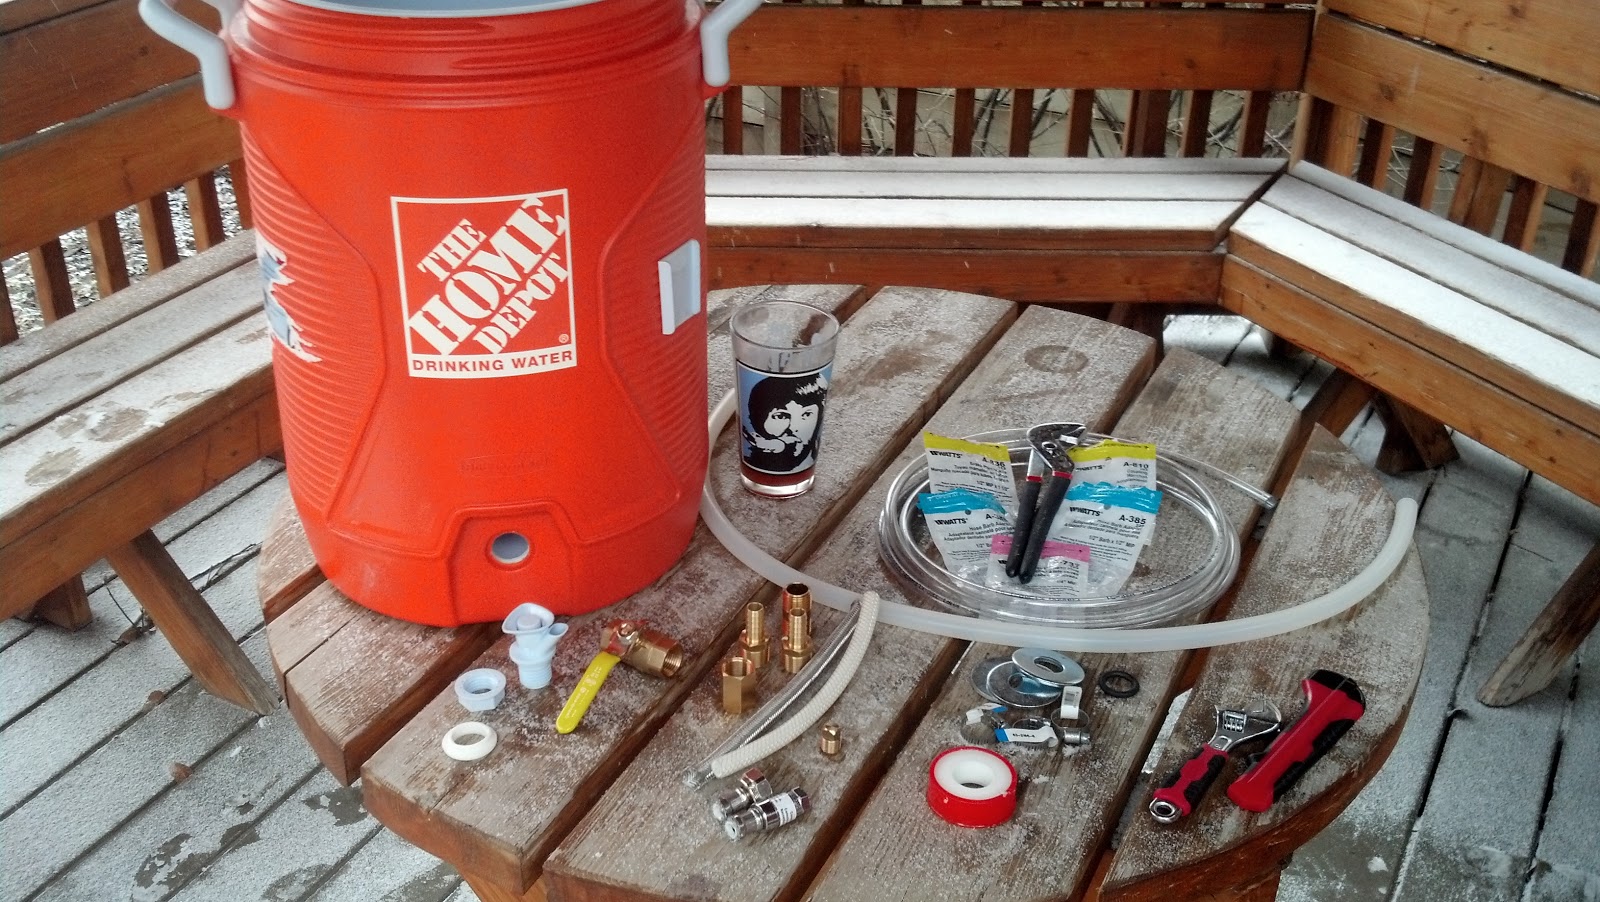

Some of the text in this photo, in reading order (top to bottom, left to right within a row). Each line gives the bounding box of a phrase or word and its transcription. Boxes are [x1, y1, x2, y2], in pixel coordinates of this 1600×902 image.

[416, 218, 487, 282] THE
[408, 196, 567, 356] HOME
[472, 252, 569, 355] DEPOT
[413, 350, 573, 372] DRINKING WATER
[930, 450, 963, 459] WATTS
[1070, 506, 1101, 517] WATTS
[1119, 514, 1147, 525] A-385
